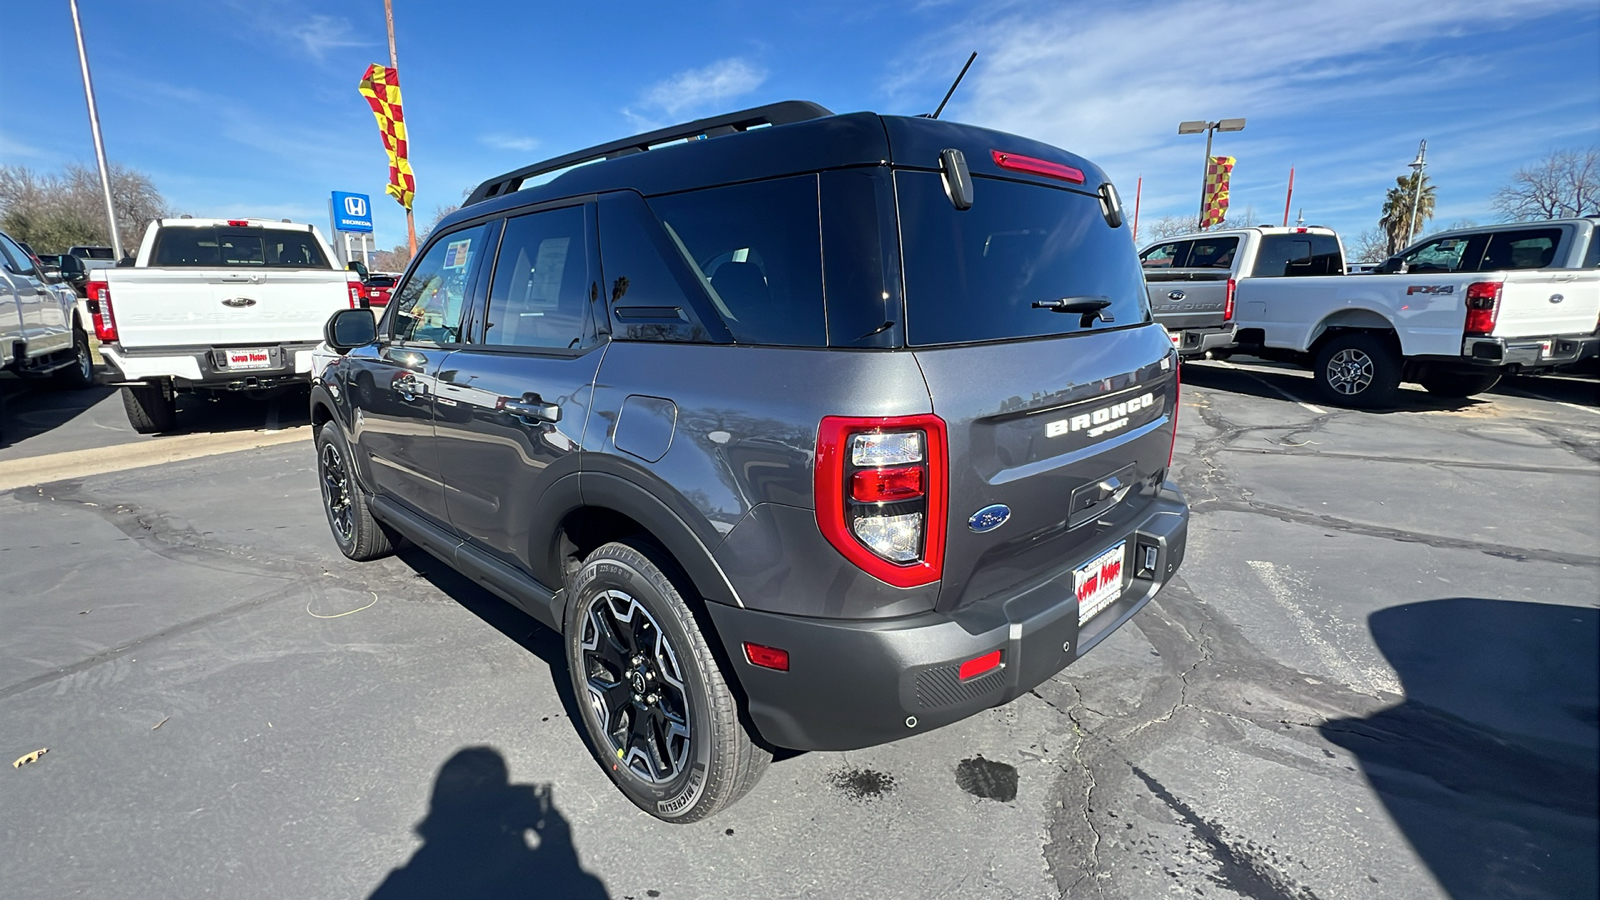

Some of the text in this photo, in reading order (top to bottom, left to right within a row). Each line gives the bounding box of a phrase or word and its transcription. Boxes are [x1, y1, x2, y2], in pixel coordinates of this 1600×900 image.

[341, 218, 372, 227] HONDA
[1407, 285, 1454, 295] FX4
[1184, 302, 1222, 310] DUTY
[1045, 393, 1153, 438] BRONCO
[1087, 417, 1129, 438] SPORT
[659, 784, 695, 813] MICHELIN
